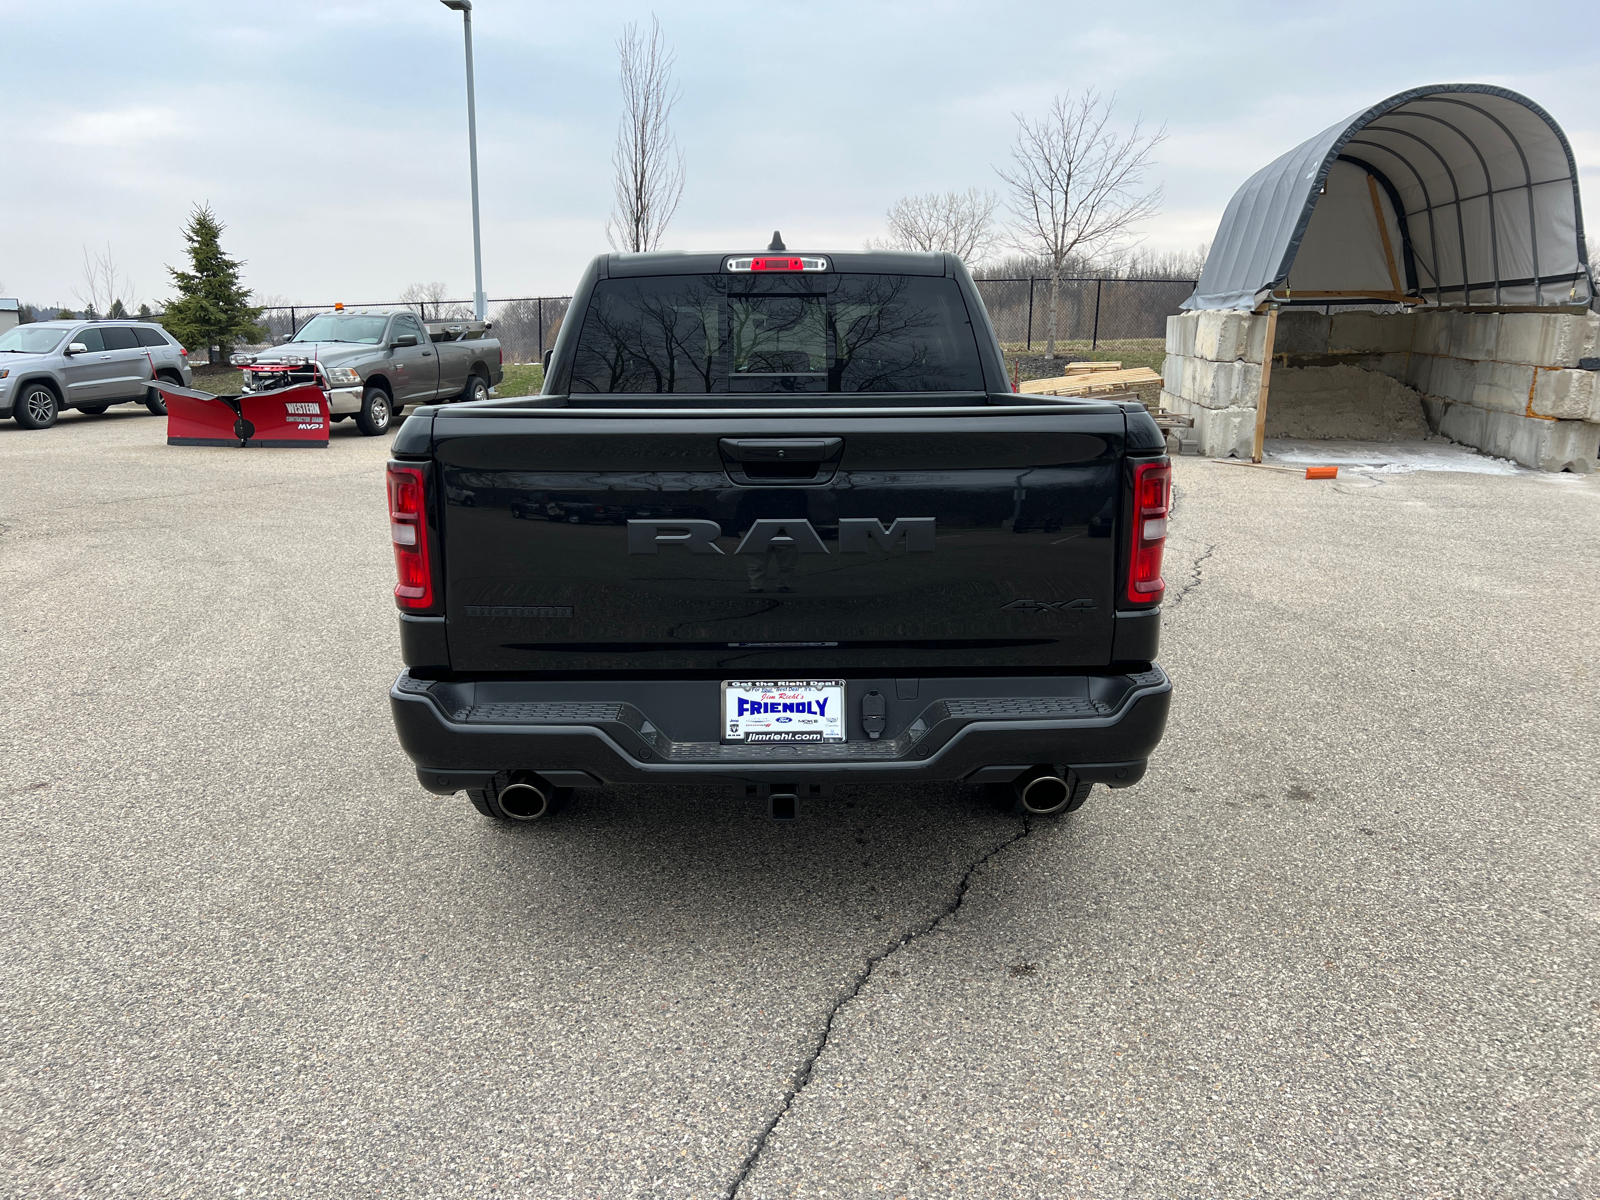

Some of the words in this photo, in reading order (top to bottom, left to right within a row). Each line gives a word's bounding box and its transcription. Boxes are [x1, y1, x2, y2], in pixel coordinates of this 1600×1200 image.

[285, 402, 320, 414] WESTERN
[626, 517, 936, 555] RAM
[761, 693, 776, 701] Jim
[778, 692, 804, 700] Riehl's
[737, 696, 829, 717] FRIENDLY
[747, 733, 820, 742] jimriehl.com
